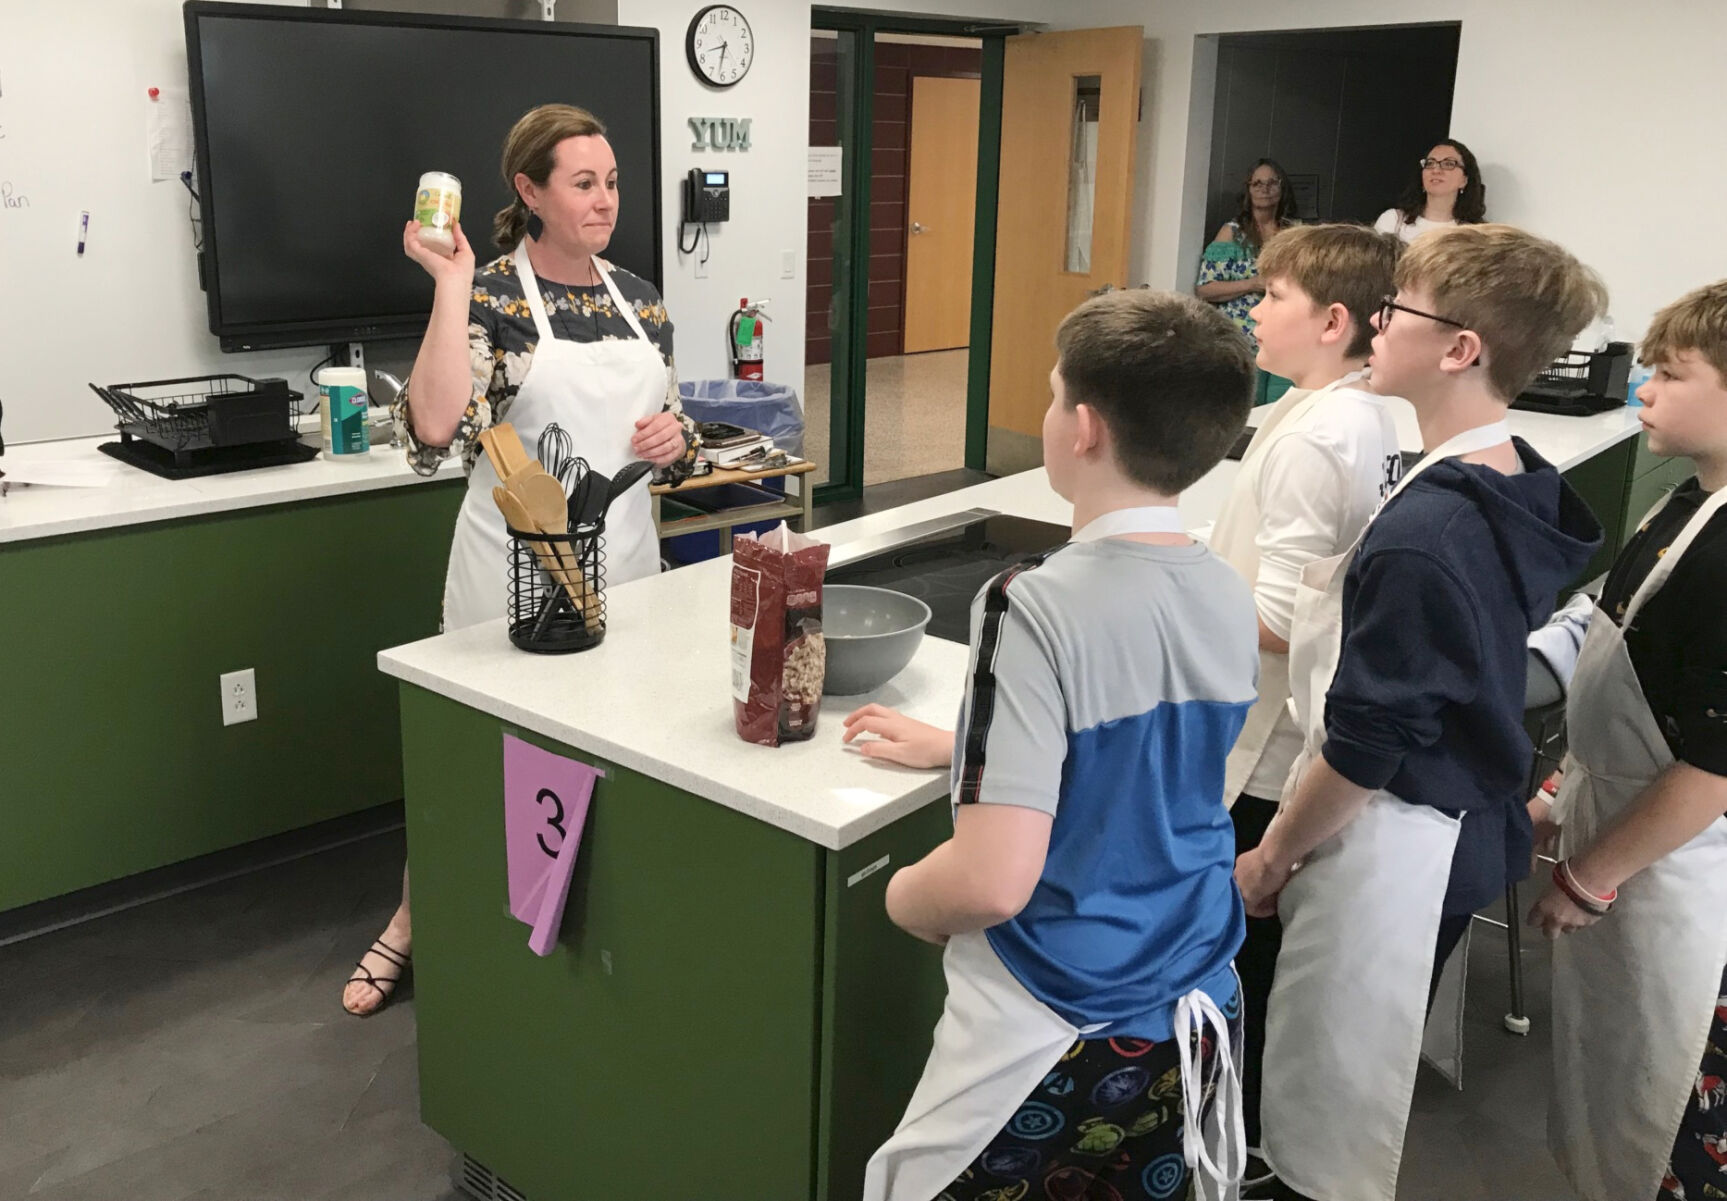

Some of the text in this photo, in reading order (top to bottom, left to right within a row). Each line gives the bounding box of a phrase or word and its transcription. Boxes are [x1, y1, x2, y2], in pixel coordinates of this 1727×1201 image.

[709, 13, 716, 25] 11
[720, 9, 729, 21] 12
[732, 16, 737, 27] 1
[740, 27, 747, 39] 2
[696, 39, 702, 50] 9
[743, 43, 750, 54] 3
[699, 53, 706, 64] 8
[740, 58, 746, 68] 4
[708, 66, 715, 77] 7
[719, 71, 726, 82] 6
[730, 68, 737, 79] 5
[688, 117, 752, 152] YUM
[1, 180, 31, 209] Pan
[535, 787, 567, 860] 3
